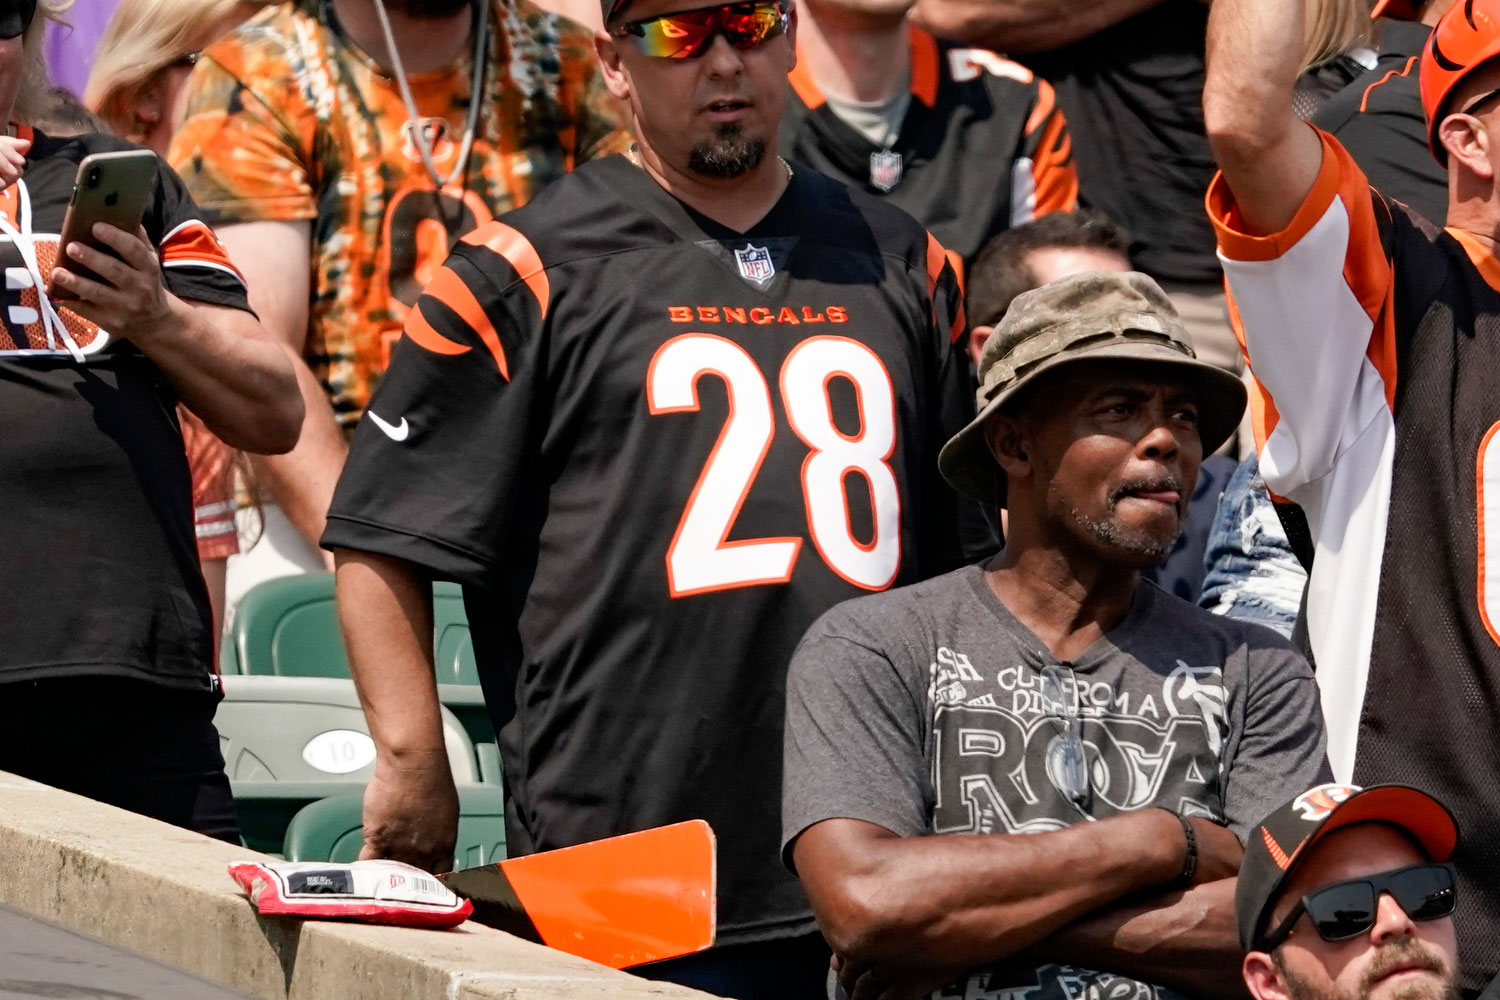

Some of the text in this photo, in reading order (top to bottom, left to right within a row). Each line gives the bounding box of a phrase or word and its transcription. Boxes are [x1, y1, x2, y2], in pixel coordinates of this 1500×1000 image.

[744, 260, 770, 277] NFL
[668, 306, 849, 325] BENGALS
[646, 332, 901, 598] 28
[1061, 676, 1130, 714] FROM
[1137, 694, 1159, 718] A
[328, 741, 355, 764] 10
